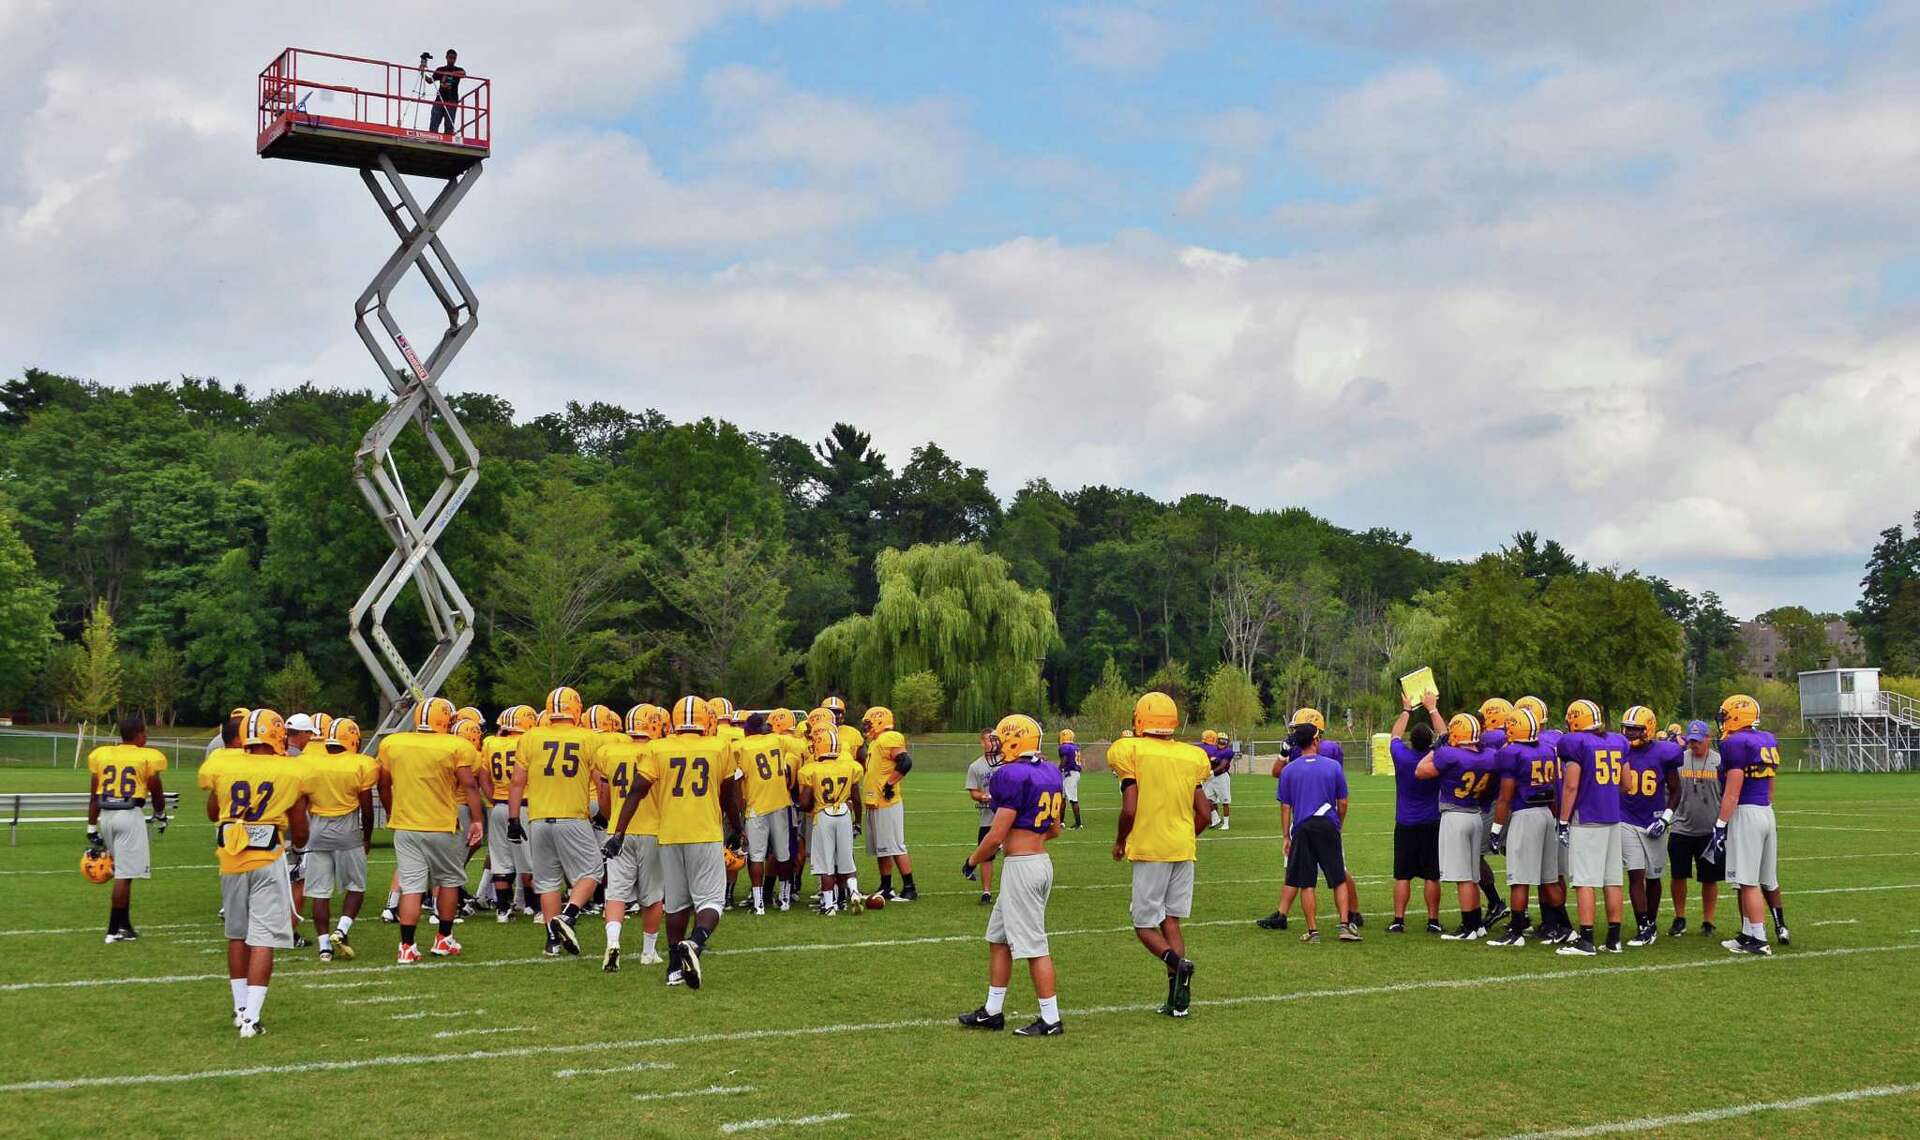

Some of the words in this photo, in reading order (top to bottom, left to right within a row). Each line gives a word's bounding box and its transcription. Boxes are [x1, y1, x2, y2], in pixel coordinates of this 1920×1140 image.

[491, 750, 516, 781] 65
[543, 741, 580, 777] 75
[755, 748, 784, 780] 87
[1594, 749, 1622, 785] 55
[103, 765, 137, 798] 26
[670, 757, 709, 797] 73
[821, 776, 849, 804] 27
